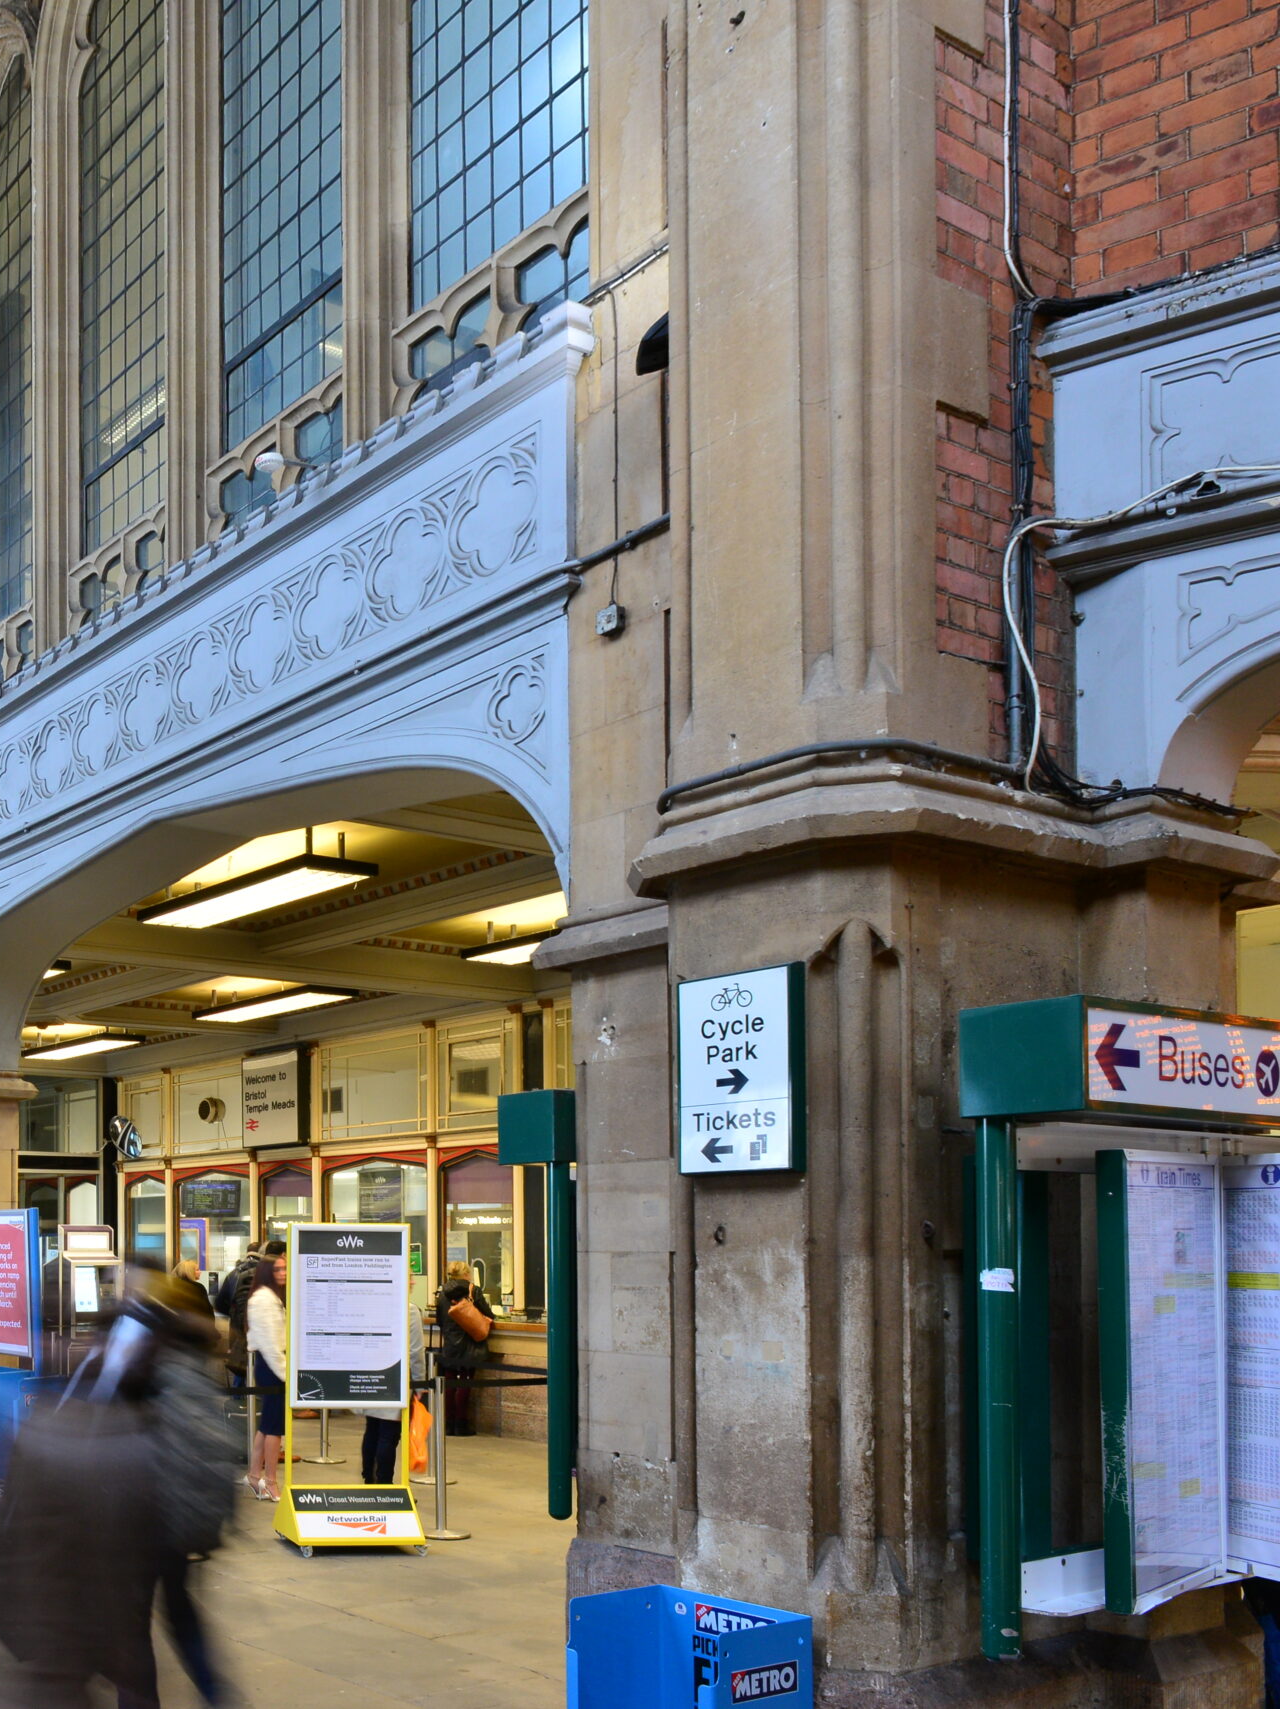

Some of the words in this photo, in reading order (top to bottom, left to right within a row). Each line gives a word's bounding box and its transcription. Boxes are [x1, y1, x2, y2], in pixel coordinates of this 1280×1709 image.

[701, 1014, 764, 1041] Cycle
[707, 1041, 758, 1065] Park
[1158, 1035, 1246, 1089] Buses
[245, 1073, 276, 1086] Welcome
[278, 1071, 287, 1080] to
[245, 1089, 267, 1101] Bristol
[246, 1103, 269, 1114] Temple
[271, 1099, 295, 1110] Meads
[692, 1108, 776, 1132] Tickets
[1155, 1166, 1176, 1185] Train
[1177, 1167, 1201, 1186] Times
[336, 1234, 364, 1249] GWR
[7, 1252, 13, 1260] of
[5, 1290, 17, 1298] until
[298, 1493, 322, 1504] GWR
[377, 1496, 404, 1504] Railway
[735, 1666, 795, 1699] METRO
